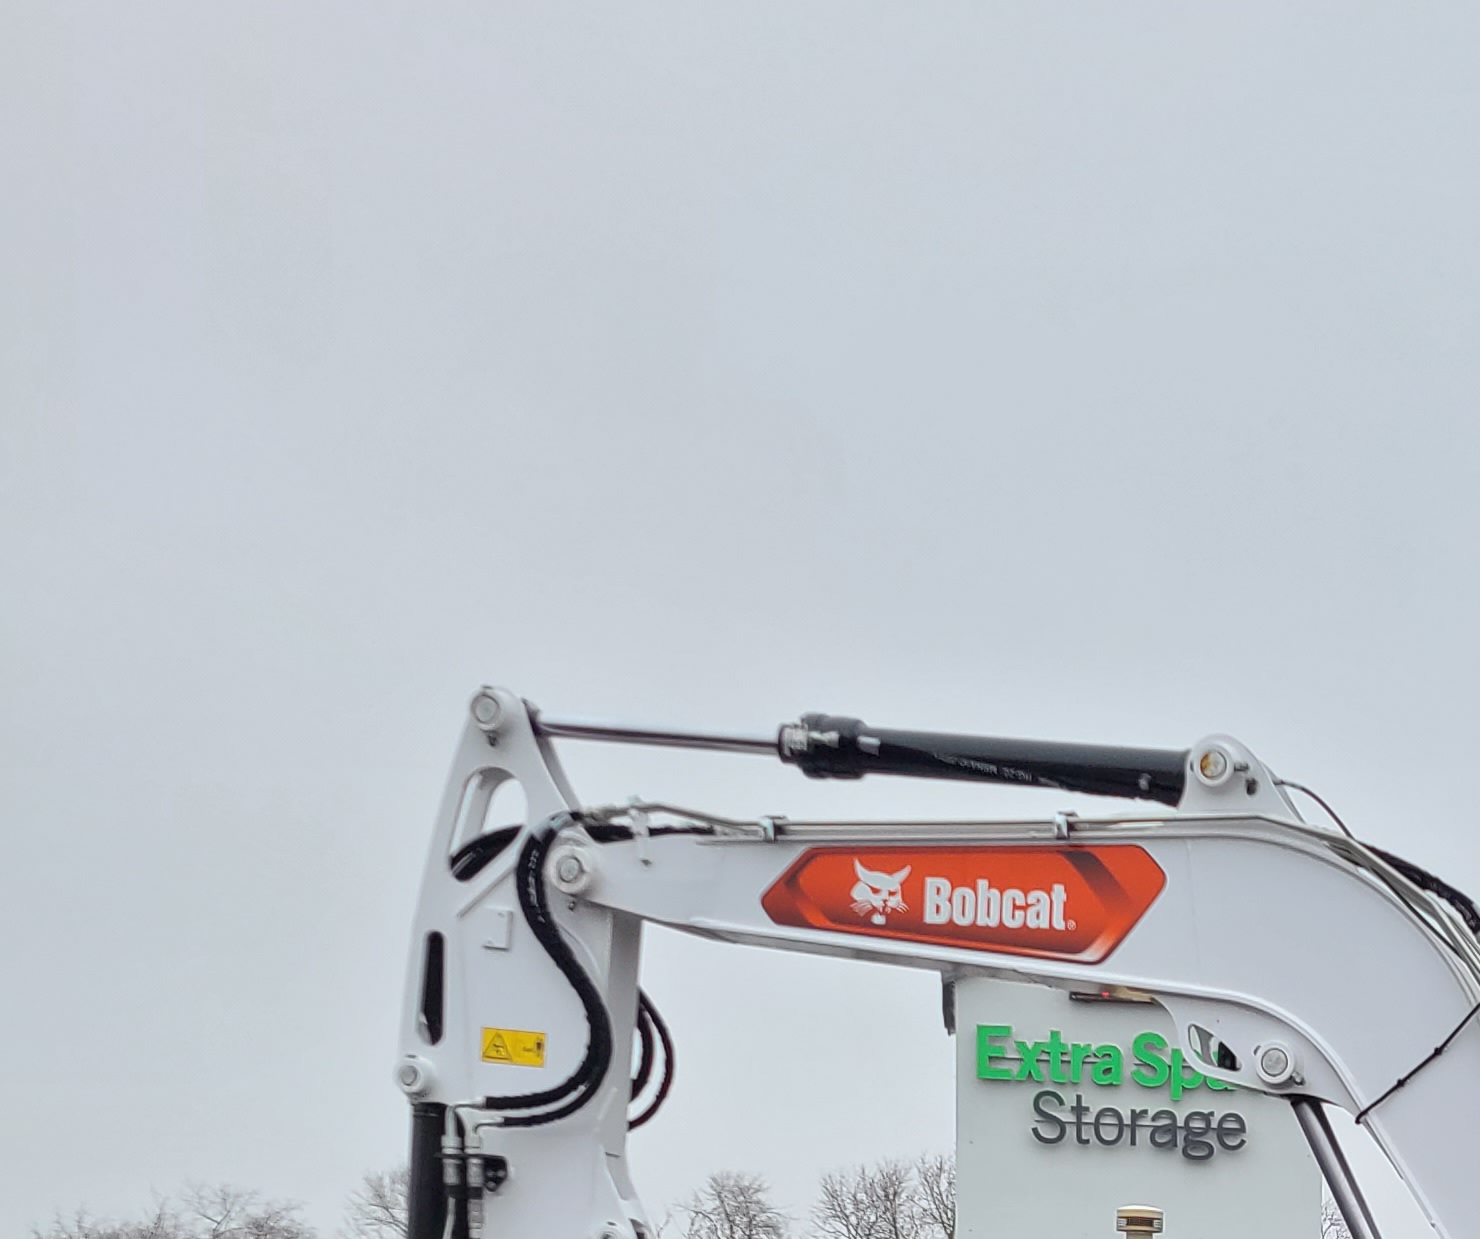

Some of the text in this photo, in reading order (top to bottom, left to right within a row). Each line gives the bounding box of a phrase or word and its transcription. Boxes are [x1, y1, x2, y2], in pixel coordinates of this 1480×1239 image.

[923, 877, 1067, 930] Bobcat
[976, 1024, 1124, 1086] Extra
[1031, 1090, 1247, 1161] Storage
